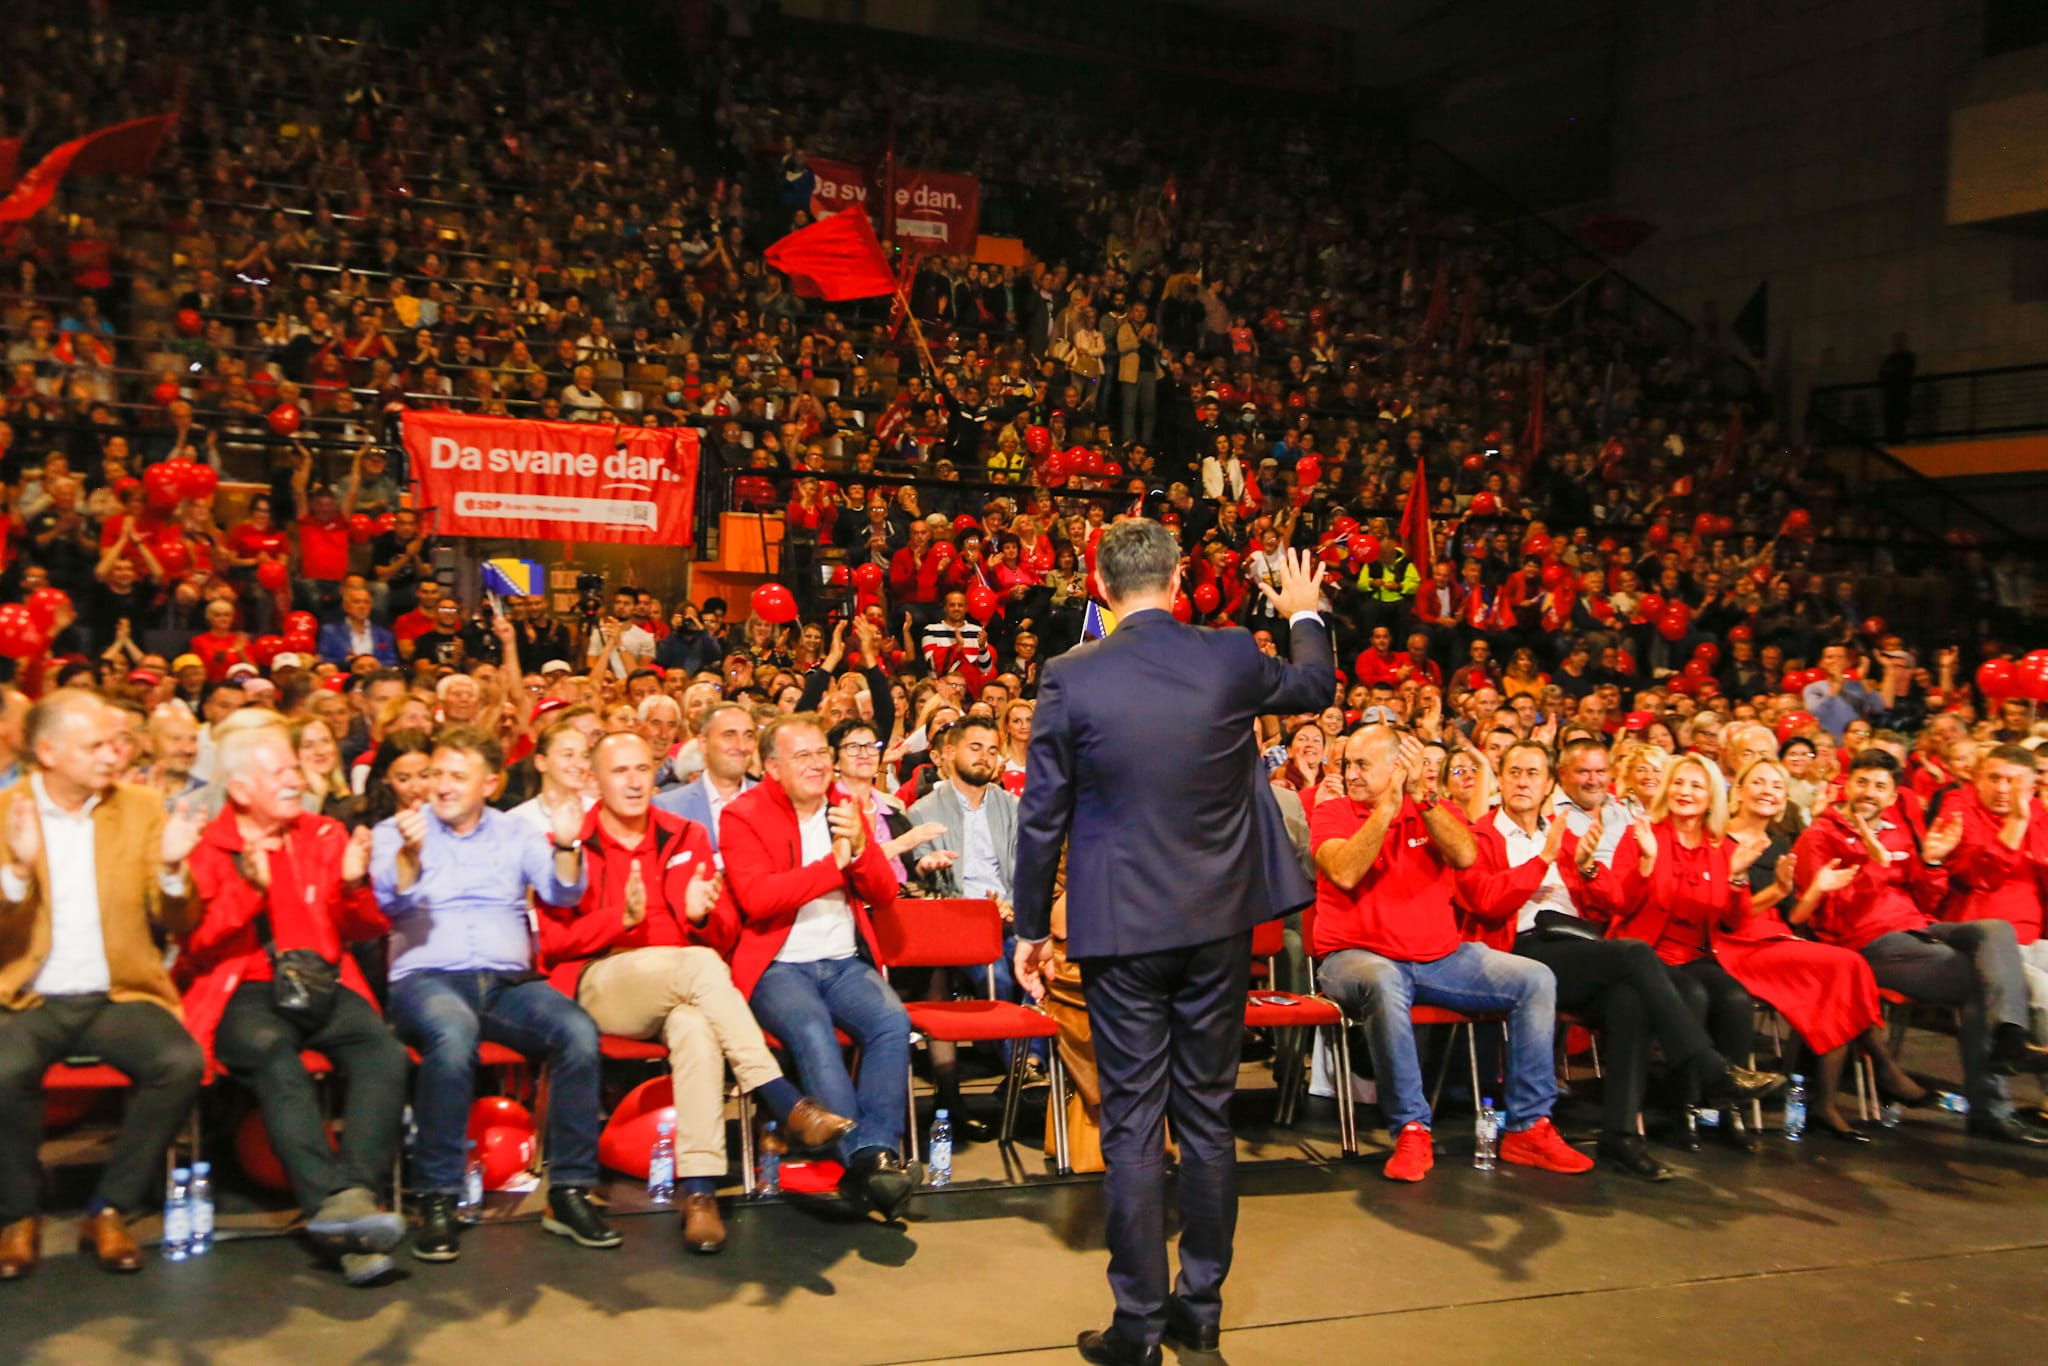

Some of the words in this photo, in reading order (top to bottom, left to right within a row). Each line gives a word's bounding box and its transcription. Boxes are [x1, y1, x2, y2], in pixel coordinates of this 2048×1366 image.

[841, 184, 910, 205] sve
[913, 184, 962, 210] dan.
[430, 436, 482, 471] Da
[488, 447, 598, 478] svane
